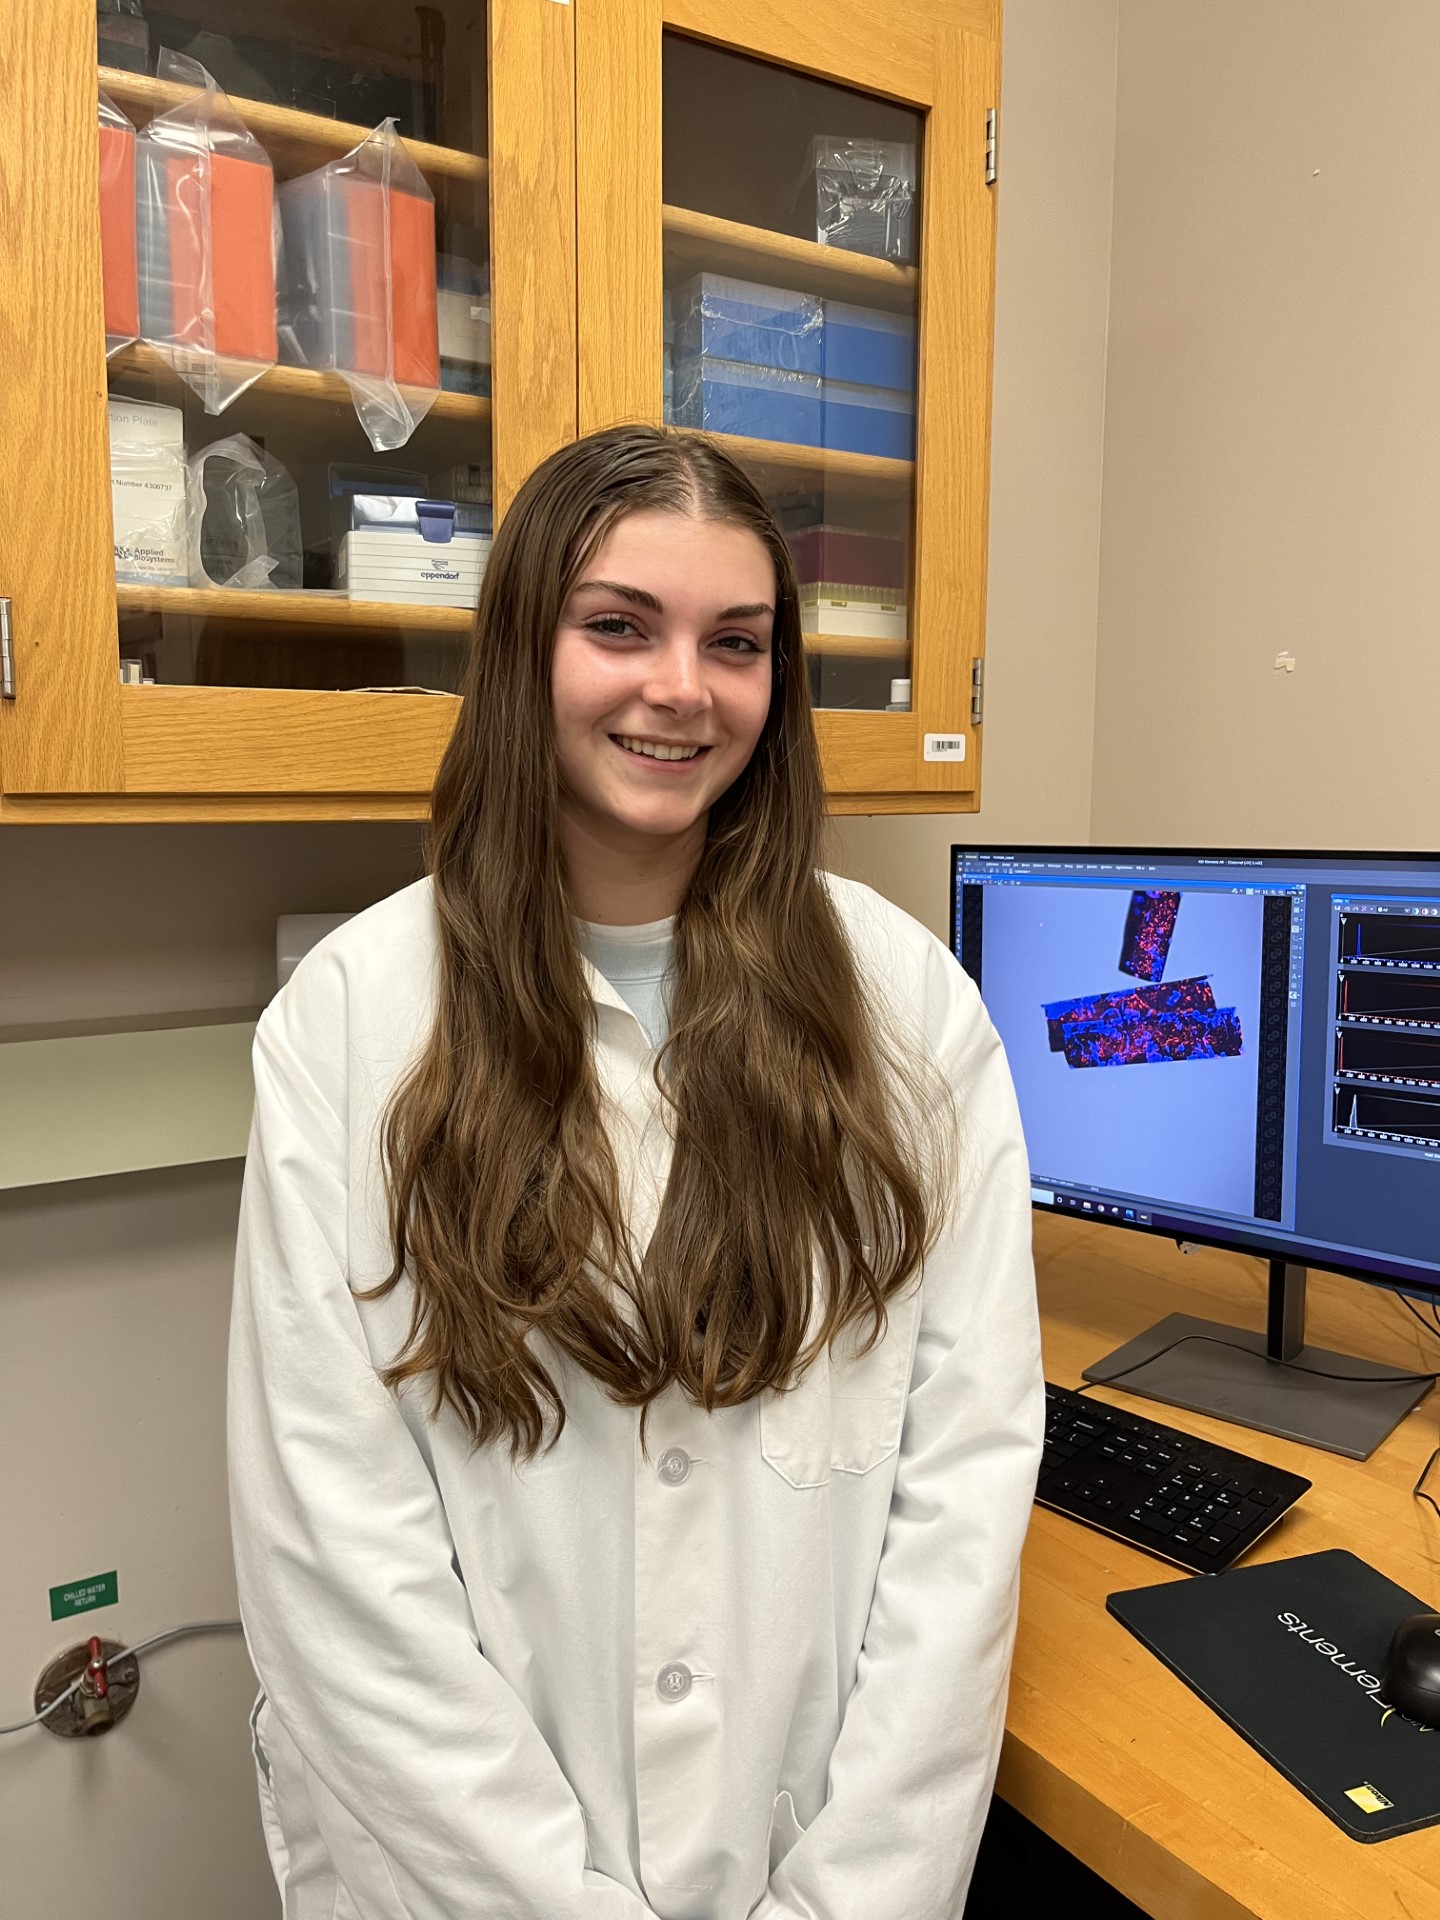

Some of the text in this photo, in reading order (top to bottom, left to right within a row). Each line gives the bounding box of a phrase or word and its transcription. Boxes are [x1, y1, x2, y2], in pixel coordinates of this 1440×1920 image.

[108, 413, 159, 427] tion Plate
[116, 479, 143, 488] Number
[134, 547, 164, 556] Applied
[134, 554, 176, 564] Biosystems
[420, 571, 460, 580] eppendorf
[63, 1583, 106, 1602] CHILLED WATER
[74, 1594, 96, 1607] RETURN
